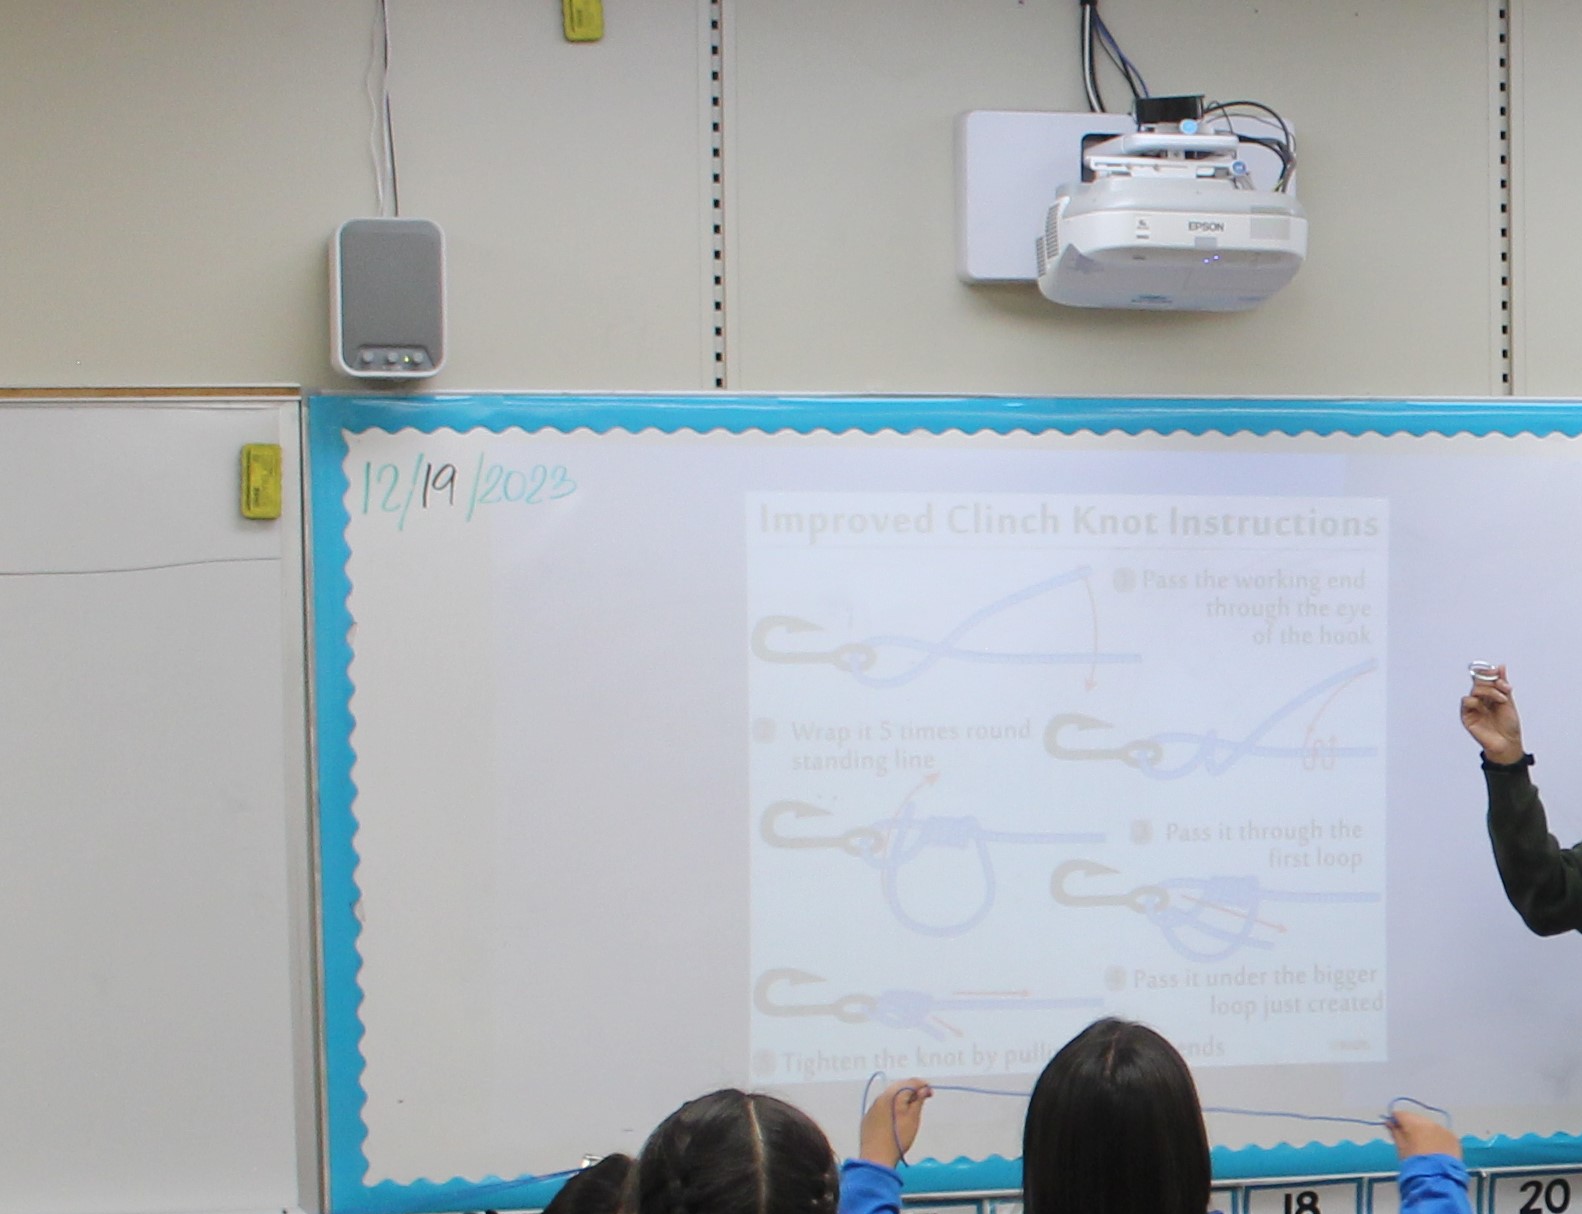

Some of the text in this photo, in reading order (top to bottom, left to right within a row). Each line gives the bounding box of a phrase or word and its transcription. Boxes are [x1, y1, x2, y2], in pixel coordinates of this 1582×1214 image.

[1187, 221, 1225, 233] EPSON
[361, 453, 579, 531] 12/19/2023
[758, 502, 1380, 547] Improved Clinch Knot Instructions
[1142, 568, 1190, 590] Pass
[1232, 569, 1321, 595] working
[1330, 570, 1367, 590] end
[1206, 596, 1292, 624] through
[1335, 602, 1373, 621] eye
[1319, 625, 1372, 646] hook
[792, 720, 851, 747] Wrap
[966, 719, 1031, 742] round
[791, 750, 936, 777] standing line
[1165, 821, 1213, 843] Pass
[1236, 820, 1324, 847] through
[1267, 847, 1363, 874] first loop
[1133, 968, 1179, 990] Pass
[1204, 966, 1268, 989] under
[1313, 964, 1378, 993] bigger
[1210, 991, 1385, 1020] loop just created
[783, 1051, 869, 1078] Tighten
[915, 1047, 964, 1070] knot
[969, 1047, 999, 1071] by
